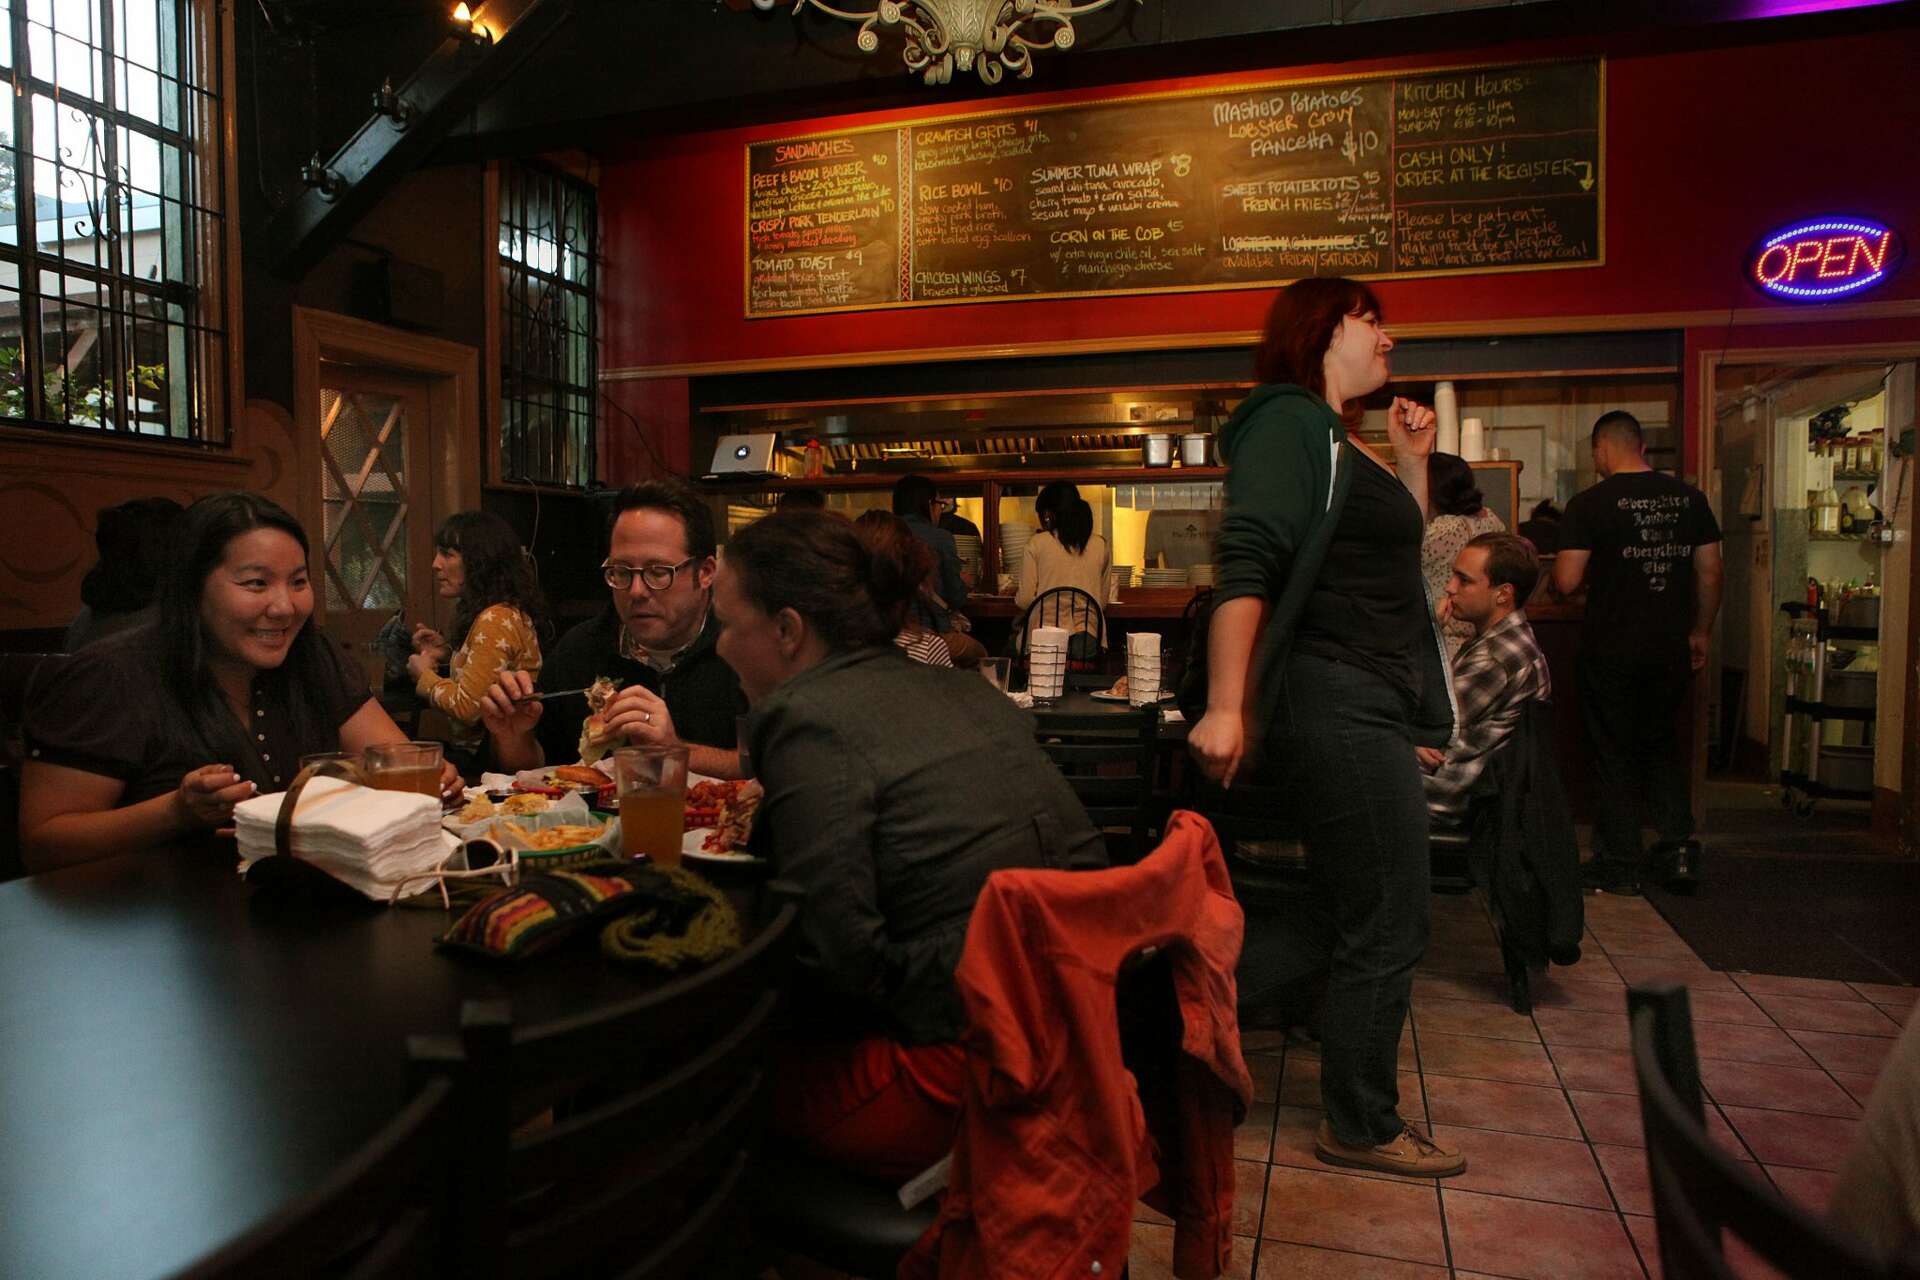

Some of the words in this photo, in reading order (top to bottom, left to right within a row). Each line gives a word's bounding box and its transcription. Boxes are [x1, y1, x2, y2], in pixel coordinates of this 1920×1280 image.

[1404, 80, 1466, 102] KITCHEN
[917, 128, 972, 146] CRAWFISH
[975, 123, 1017, 141] GRITS
[776, 140, 854, 161] SANDWICHES
[1399, 149, 1444, 168] CASH
[753, 173, 779, 190] BEEF
[790, 167, 819, 183] BACON
[822, 161, 867, 180] BURGER
[1030, 166, 1084, 184] SUMMER
[1085, 163, 1118, 178] TUNA
[1122, 160, 1162, 177] WRAP
[1395, 168, 1445, 188] ORDER
[1450, 169, 1465, 183] AT
[1470, 166, 1493, 181] THE
[1497, 159, 1577, 180] REGISTER
[920, 185, 949, 201] RICE
[952, 182, 990, 198] BOWL
[1102, 191, 1124, 201] corn
[1223, 182, 1268, 197] SWEET
[1243, 195, 1291, 212] FRENCH
[1294, 196, 1335, 211] FRIES
[751, 218, 785, 234] CRISPY
[790, 213, 815, 230] PORK
[816, 206, 879, 225] TENDERLOIN
[1396, 210, 1445, 226] Please
[1451, 208, 1474, 225] be
[1050, 228, 1089, 243] CORN
[1092, 229, 1106, 240] ON
[1111, 228, 1131, 241] THE
[1135, 225, 1165, 241] COB
[1437, 230, 1459, 241] are
[1496, 224, 1509, 238] 2
[752, 258, 795, 272] TOMATO
[799, 256, 835, 271] TOAST
[1757, 231, 1890, 282] OPEN
[915, 272, 960, 285] CHICKEN
[962, 270, 1001, 283] WINGS
